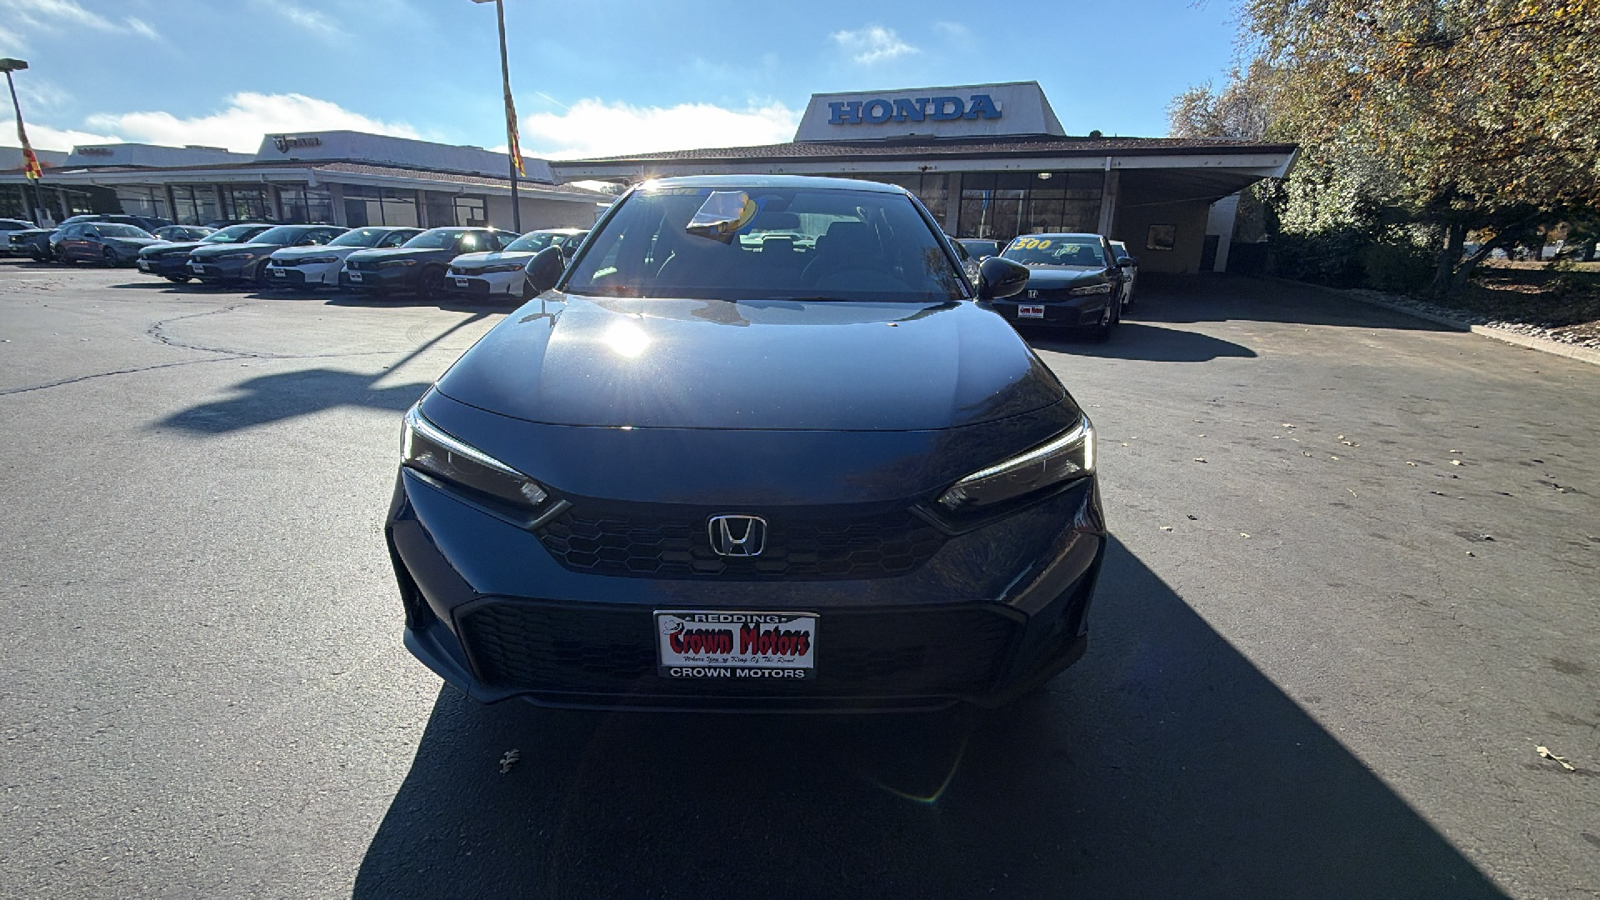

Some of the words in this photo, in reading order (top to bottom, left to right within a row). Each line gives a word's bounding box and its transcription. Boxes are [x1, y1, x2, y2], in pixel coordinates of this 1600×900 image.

[827, 94, 1002, 126] HONDA
[694, 614, 779, 623] REDDING
[669, 622, 734, 655] Crown
[739, 622, 811, 656] Motors
[670, 668, 731, 678] CROWN
[736, 669, 805, 679] MOTORS
